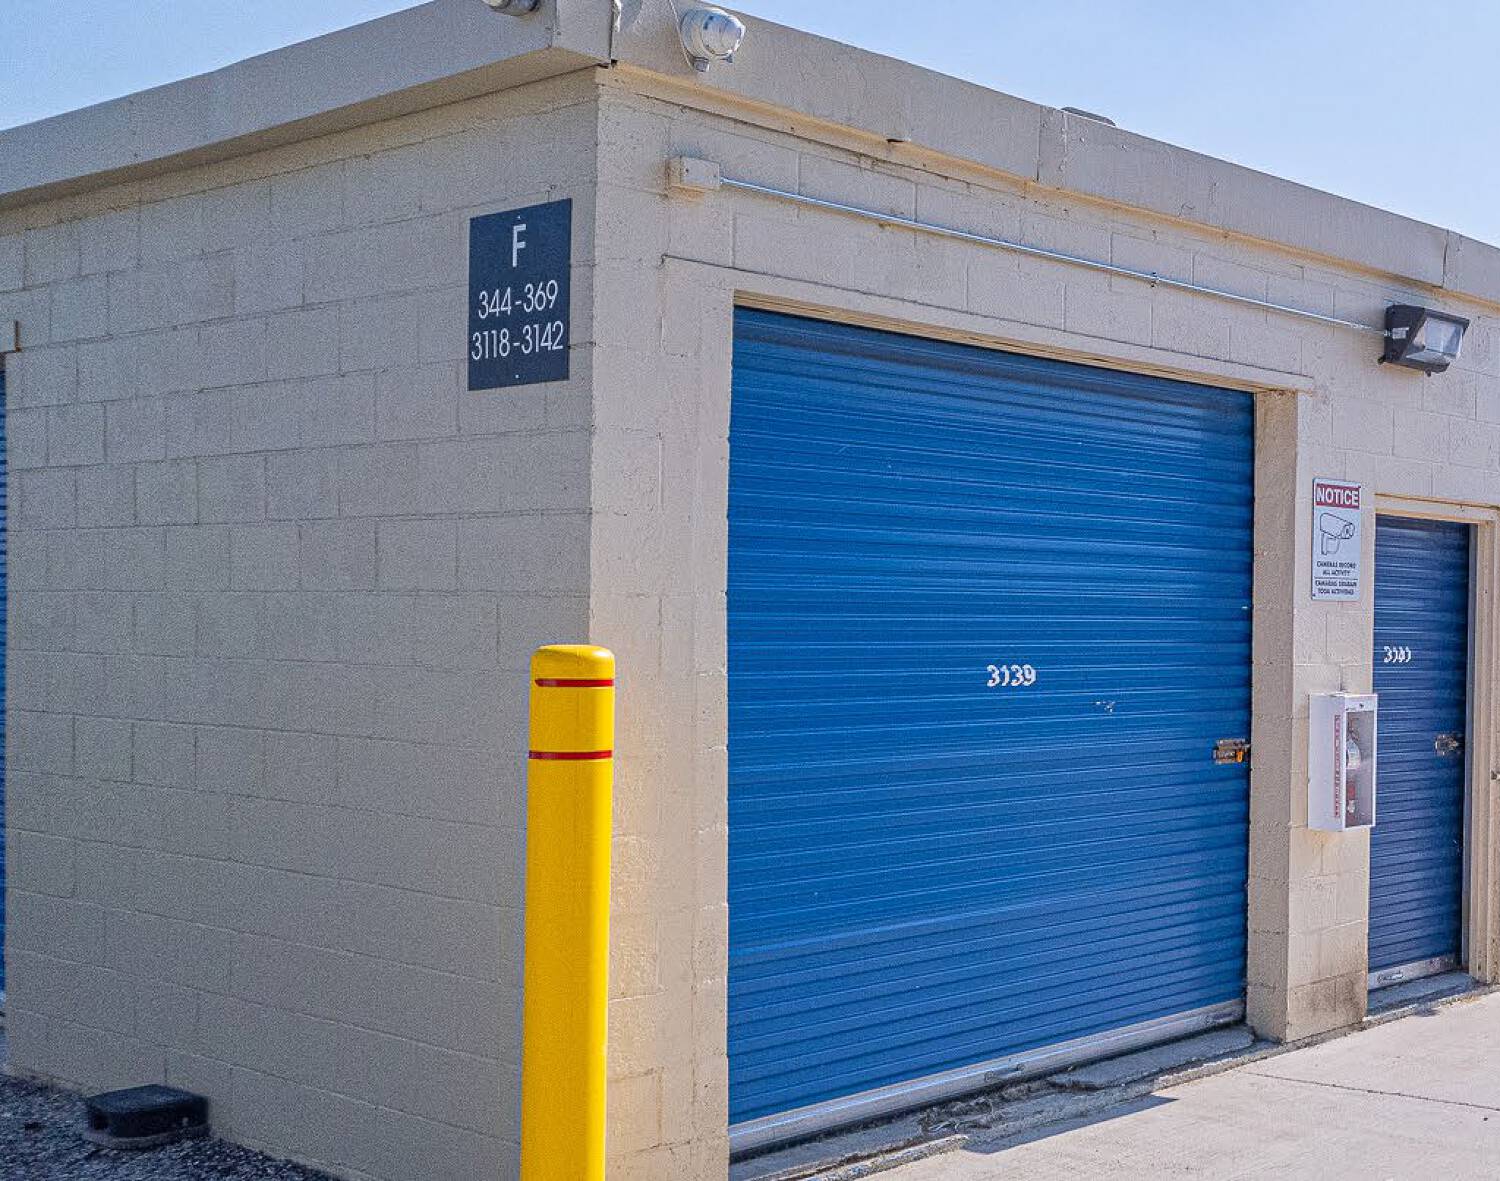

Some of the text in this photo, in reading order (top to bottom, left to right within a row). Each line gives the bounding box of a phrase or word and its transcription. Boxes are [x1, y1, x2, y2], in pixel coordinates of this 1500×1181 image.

[512, 223, 527, 268] F
[478, 279, 559, 319] 344-369
[471, 320, 564, 360] 3118-3142
[1317, 487, 1359, 506] NOTICE
[986, 664, 1037, 687] 3139
